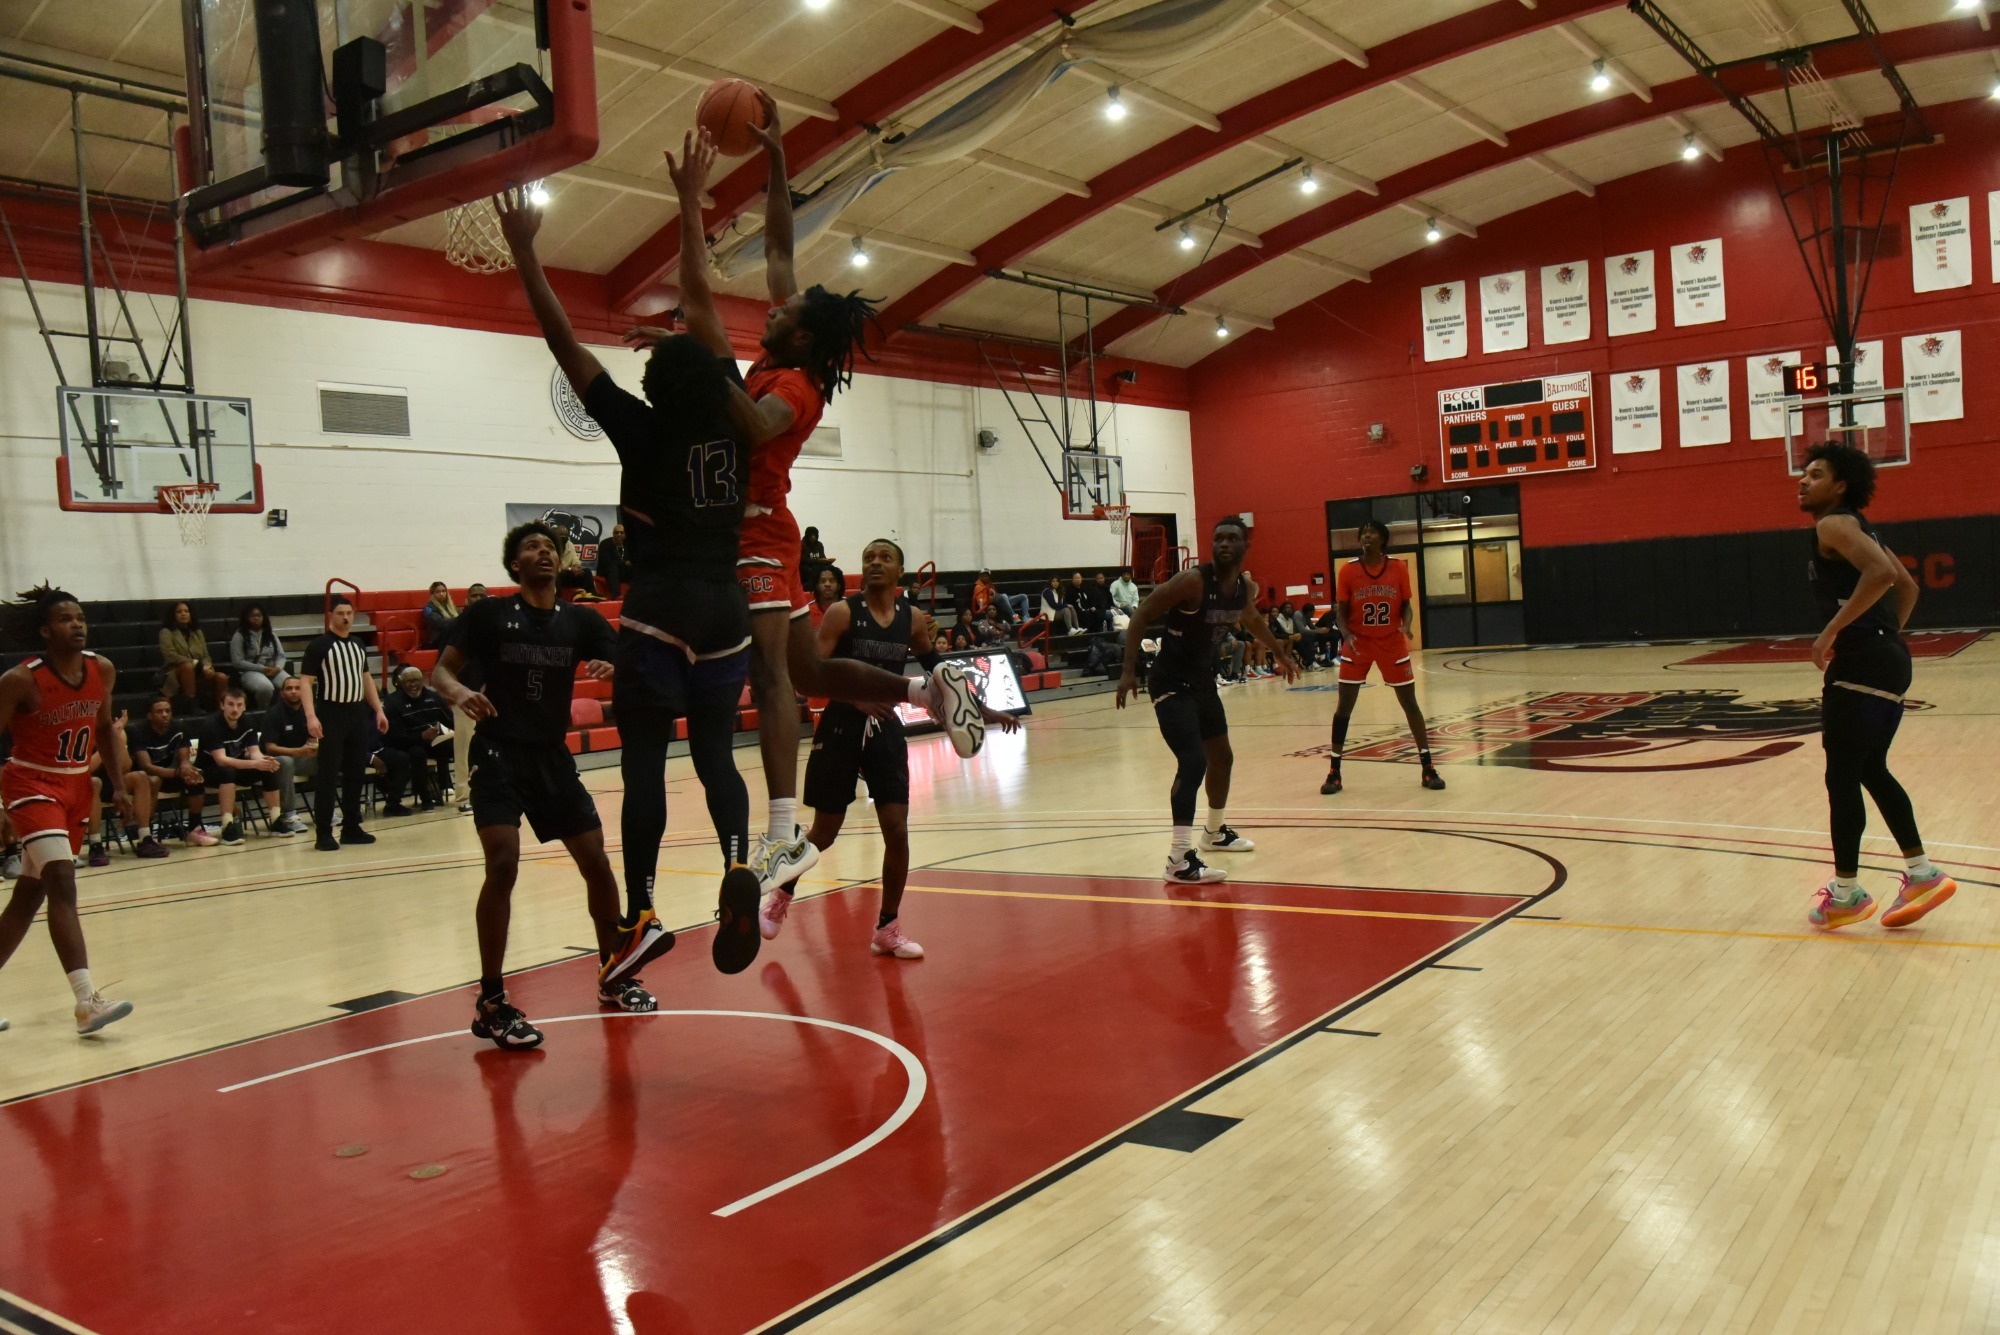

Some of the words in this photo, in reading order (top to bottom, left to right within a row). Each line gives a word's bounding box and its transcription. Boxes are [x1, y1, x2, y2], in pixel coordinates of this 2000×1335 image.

[1546, 378, 1588, 398] BALTIMORE
[1796, 366, 1817, 390] 16
[1443, 389, 1479, 402] BCCC
[1552, 400, 1580, 412] GUEST
[562, 400, 584, 428] ATHLETIC
[1443, 411, 1487, 425] PANTHERS
[1504, 413, 1526, 422] PERIOD
[1449, 446, 1468, 455] FOULS
[1495, 440, 1518, 450] PLAYER
[1522, 438, 1538, 447] FOUL
[1566, 433, 1585, 442] FOULS
[687, 438, 739, 508] 13
[1451, 471, 1469, 479] SCORE
[1507, 465, 1526, 474] MATCH
[1567, 459, 1587, 468] SCORE
[1362, 601, 1391, 627] 22
[527, 669, 544, 701] 5
[55, 725, 91, 763] 10
